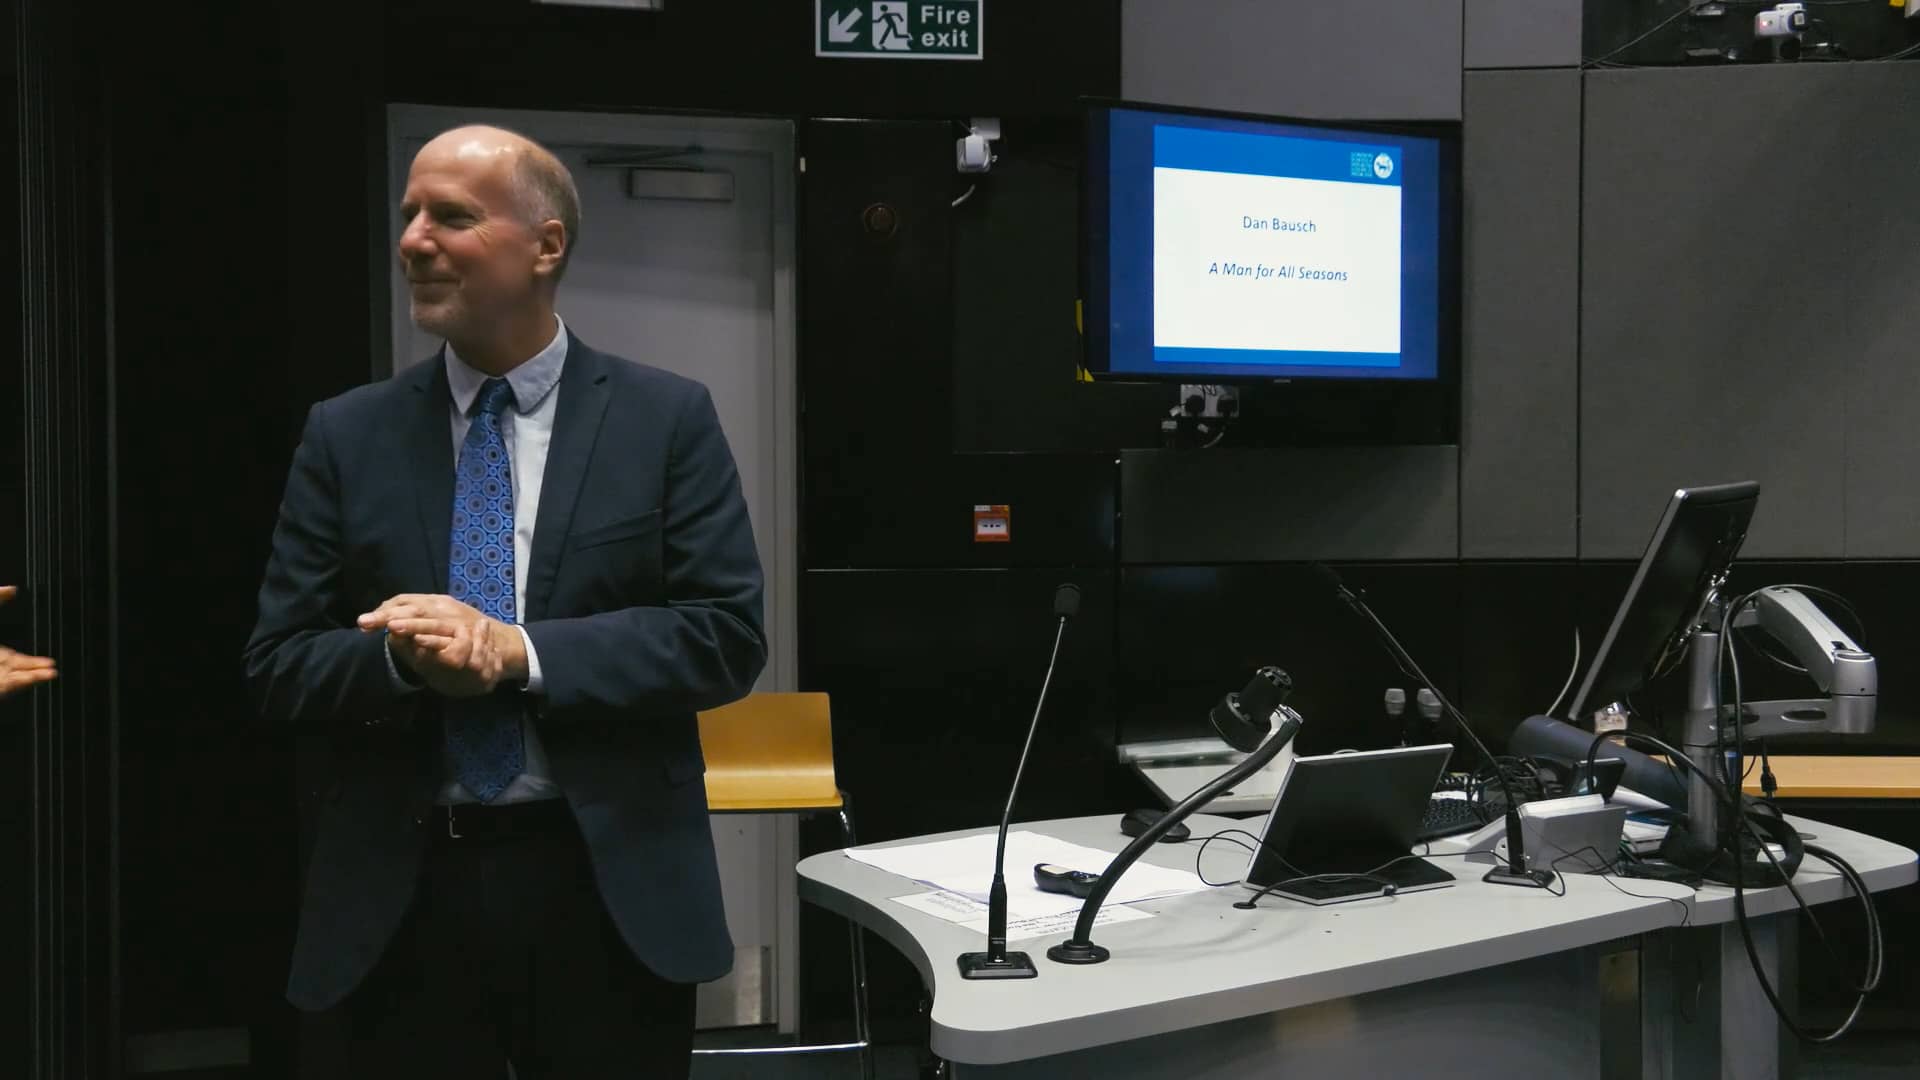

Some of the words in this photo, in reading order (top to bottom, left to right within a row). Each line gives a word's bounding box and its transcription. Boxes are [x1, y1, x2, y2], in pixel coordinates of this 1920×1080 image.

[921, 5, 971, 24] Fire
[921, 28, 969, 48] exit
[1243, 215, 1268, 230] Dan
[1272, 217, 1317, 233] Bausch
[1209, 262, 1219, 275] A
[1222, 262, 1253, 277] Man
[1255, 263, 1275, 280] for
[1277, 265, 1295, 278] All
[1298, 266, 1349, 281] Seasons
